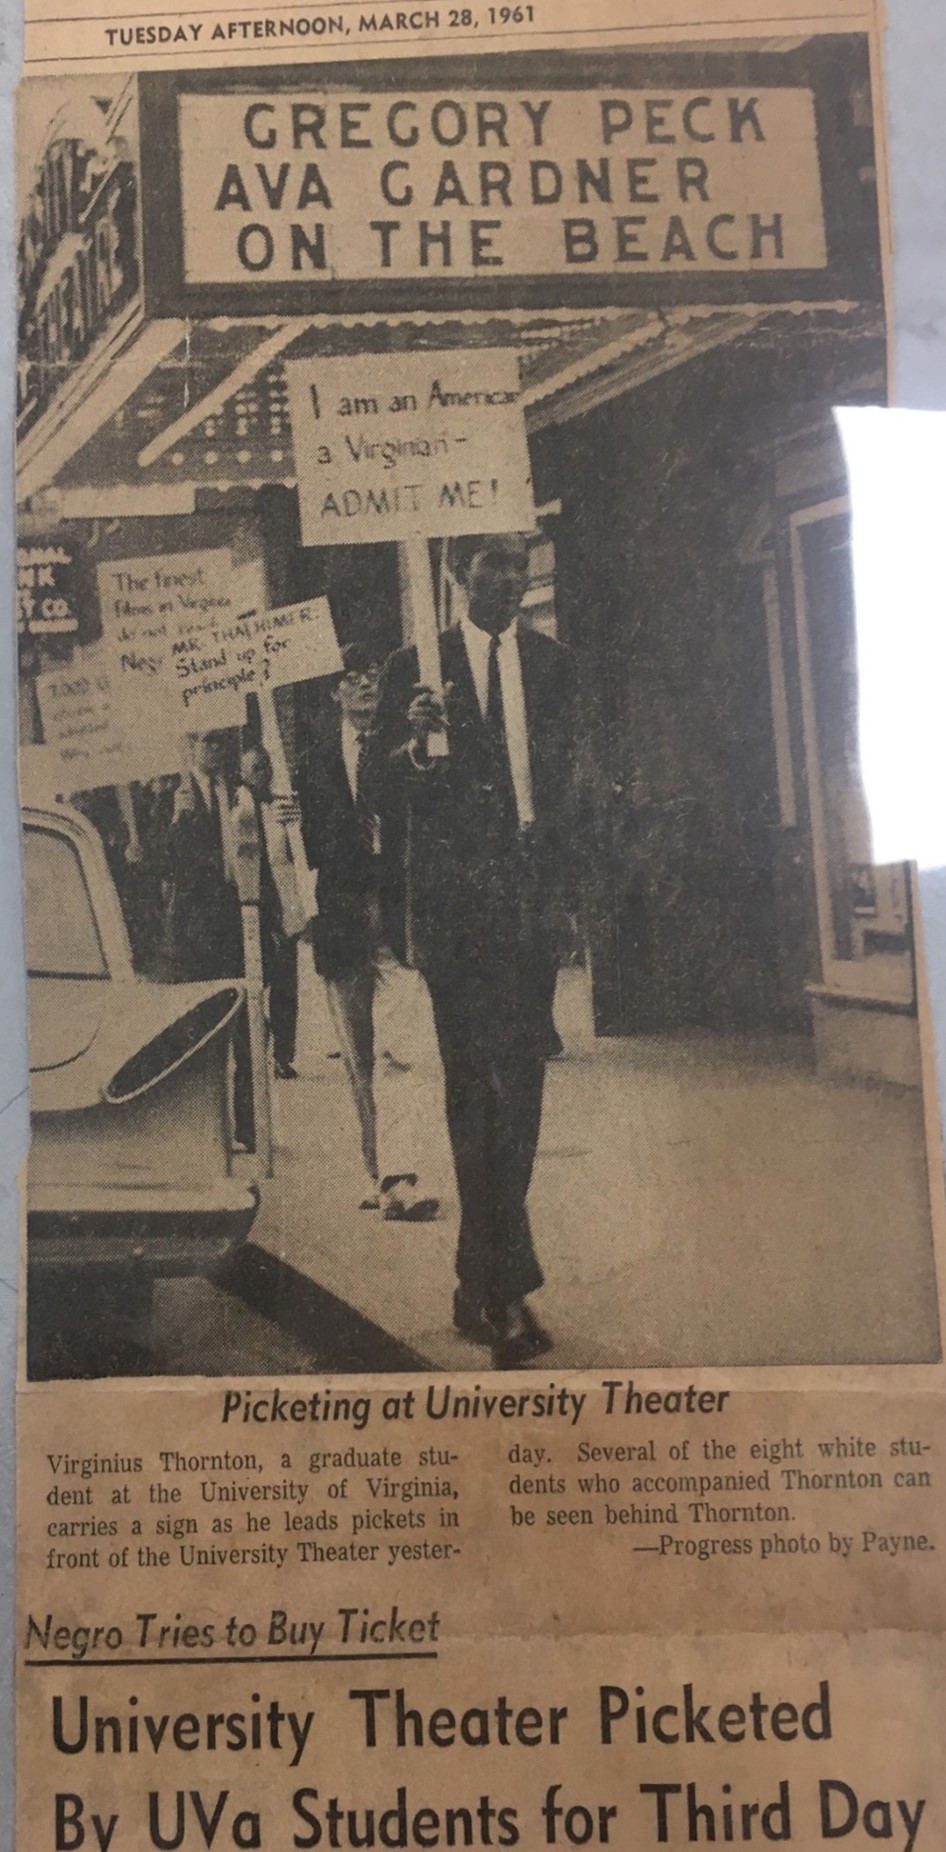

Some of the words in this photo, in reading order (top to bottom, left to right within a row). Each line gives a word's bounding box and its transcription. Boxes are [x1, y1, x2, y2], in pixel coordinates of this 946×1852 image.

[104, 23, 204, 47] TUESDAY
[210, 15, 351, 41] AFTERNOON,
[358, 10, 440, 32] MARCH
[448, 8, 479, 29] 28,
[487, 4, 534, 25] 1961
[243, 99, 553, 150] GREGORY
[601, 95, 767, 146] PECK
[214, 162, 333, 212] AVA
[380, 156, 711, 208] GARDNER
[236, 222, 328, 273] ON
[369, 219, 505, 269] THE
[561, 212, 785, 265] BEACH
[309, 384, 321, 420] I
[337, 396, 379, 416] am
[388, 394, 418, 413] an
[317, 444, 333, 465] a
[320, 484, 423, 519] ADMIT
[438, 478, 499, 508] ME!
[111, 572, 149, 593] The
[176, 648, 227, 678] Stand
[236, 648, 256, 665] up
[263, 633, 290, 654] for
[221, 1388, 372, 1431] Picketing
[382, 1390, 416, 1421] at
[425, 1382, 587, 1426] University
[601, 1380, 731, 1415] Theater
[46, 1452, 143, 1480] Virginius
[159, 1450, 264, 1474] Thornton,
[280, 1452, 292, 1469] a
[308, 1448, 402, 1473] graduate
[418, 1445, 459, 1467] stu-
[507, 1443, 552, 1469] day.
[577, 1439, 657, 1463] Several
[668, 1439, 691, 1461] of
[702, 1438, 737, 1461] the
[749, 1437, 805, 1465] eight
[817, 1435, 877, 1459] white
[889, 1436, 932, 1457] stu-
[46, 1485, 94, 1506] dent
[110, 1484, 132, 1505] at
[148, 1482, 182, 1504] the
[200, 1479, 310, 1506] University
[327, 1478, 349, 1500] of
[365, 1476, 459, 1502] Virginia,
[508, 1473, 566, 1495] dents
[577, 1472, 621, 1494] who
[631, 1469, 771, 1497] accompanied
[780, 1468, 883, 1491] Thornton
[893, 1471, 932, 1488] can
[46, 1515, 118, 1538] carries
[131, 1519, 142, 1536] a
[155, 1513, 199, 1540] sign
[211, 1517, 233, 1534] as
[246, 1511, 271, 1533] he
[284, 1509, 339, 1532] leads
[351, 1508, 426, 1536] pickets
[439, 1507, 460, 1528] in
[509, 1504, 536, 1527] be
[546, 1509, 594, 1526] seen
[604, 1502, 679, 1525] behind
[687, 1501, 796, 1524] Thornton.
[45, 1548, 100, 1570] front
[108, 1546, 130, 1568] of
[137, 1546, 170, 1567] the
[178, 1542, 289, 1569] University
[296, 1541, 380, 1563] Theater
[387, 1539, 462, 1567] yester-
[759, 1532, 821, 1560] photo
[827, 1531, 854, 1557] by
[861, 1530, 936, 1557] Payne.
[23, 1616, 123, 1654] Negro
[135, 1612, 215, 1649] Tries
[225, 1616, 258, 1648] to
[267, 1610, 325, 1654] Buy
[338, 1605, 441, 1644] Ticket
[52, 1692, 315, 1768] University
[348, 1687, 568, 1748] Theater
[599, 1679, 833, 1745] Picketed
[54, 1793, 118, 1852] By
[147, 1789, 262, 1849] UVa
[292, 1787, 520, 1850] Students
[541, 1786, 618, 1846] for
[639, 1780, 792, 1843] Third
[818, 1779, 927, 1852] Day
